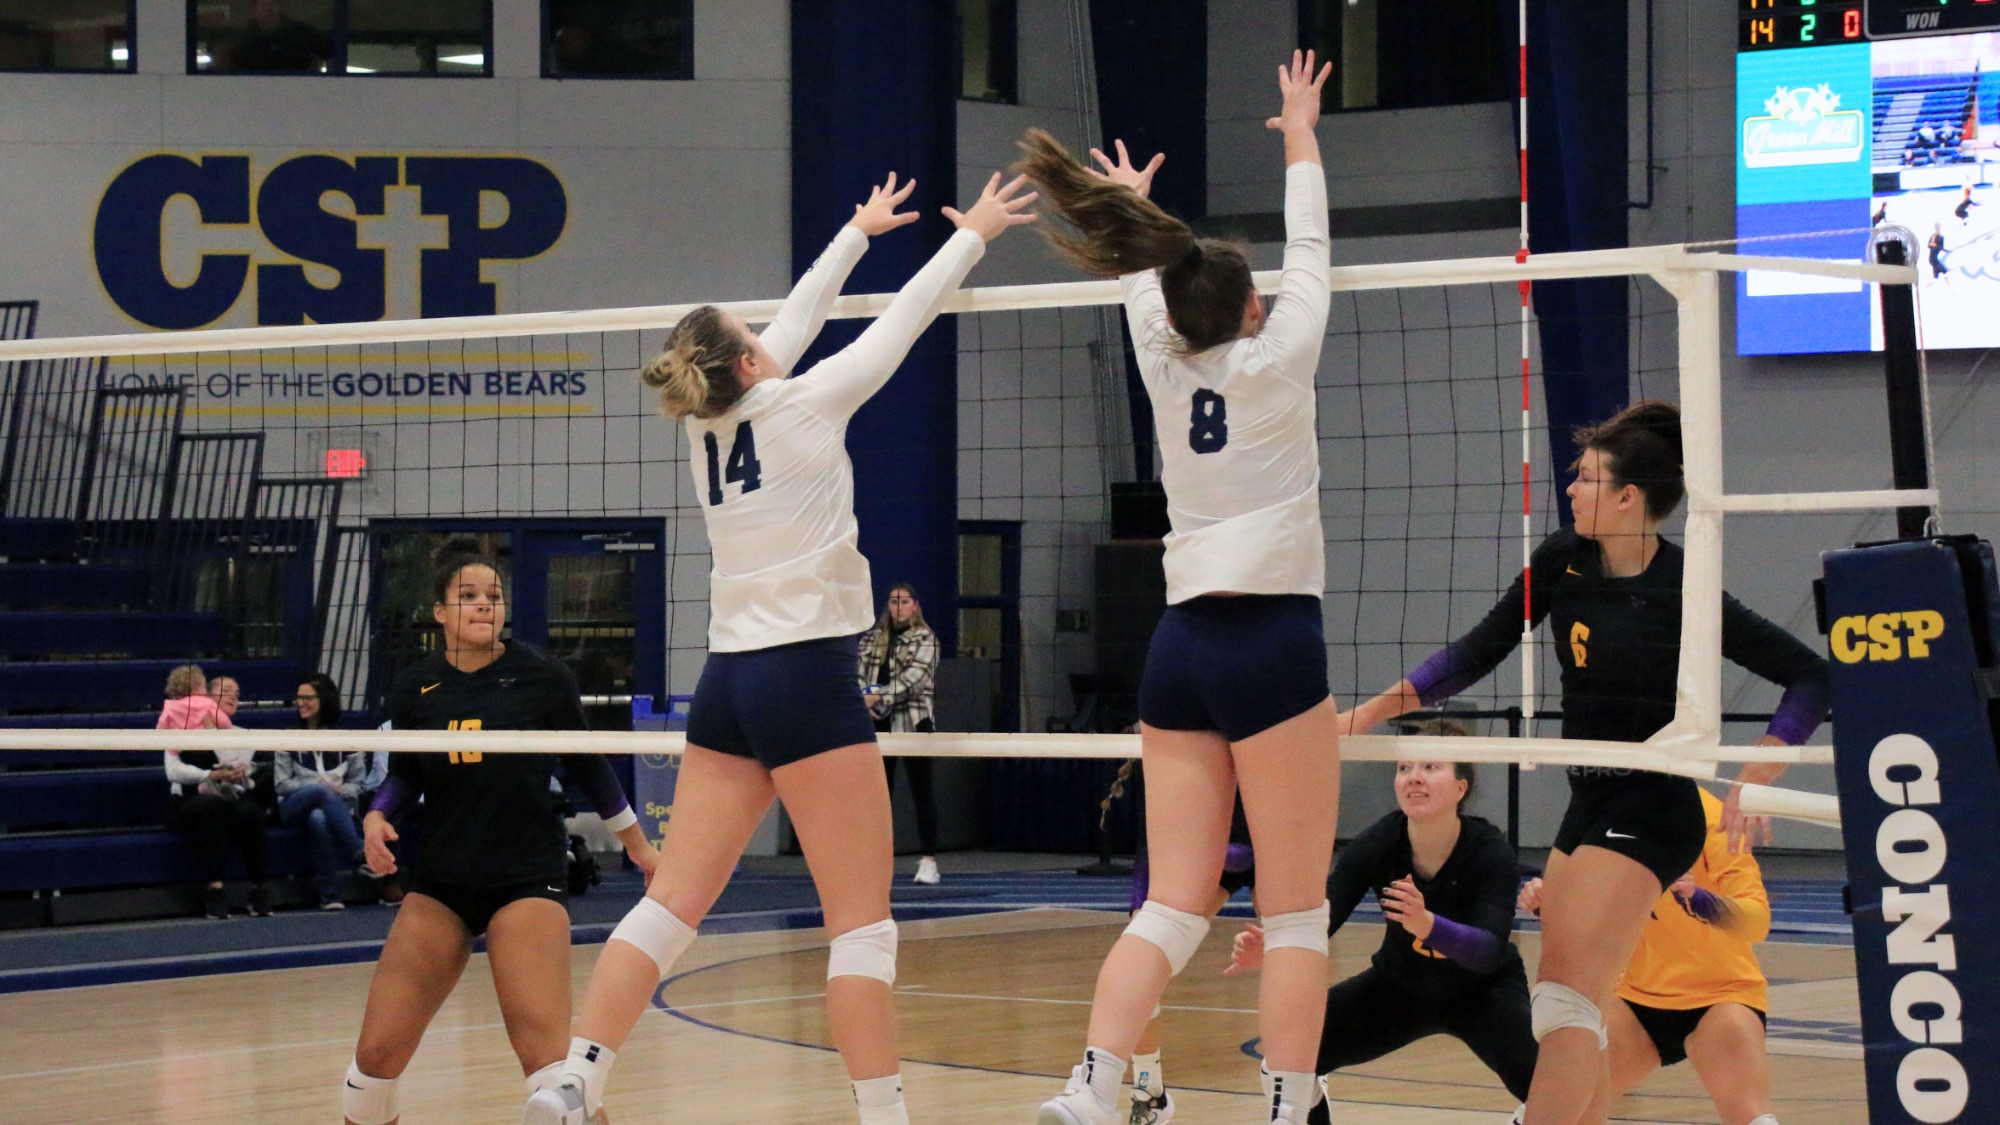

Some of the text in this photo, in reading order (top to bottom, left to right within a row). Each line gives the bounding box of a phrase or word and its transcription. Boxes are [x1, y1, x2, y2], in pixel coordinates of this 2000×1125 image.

[1750, 10, 1860, 45] 14 2 0
[1906, 12, 1940, 30] WON
[1808, 118, 1857, 146] Mill
[92, 152, 570, 331] CSP
[207, 373, 251, 398] OF
[261, 372, 323, 397] THE
[332, 371, 472, 397] GOLDEN
[485, 371, 586, 396] BEARS
[1189, 388, 1228, 454] 8
[704, 419, 762, 507] 14
[1570, 621, 1590, 667] 6
[1830, 610, 1945, 664] CSP
[1868, 733, 1969, 1125] CONCO
